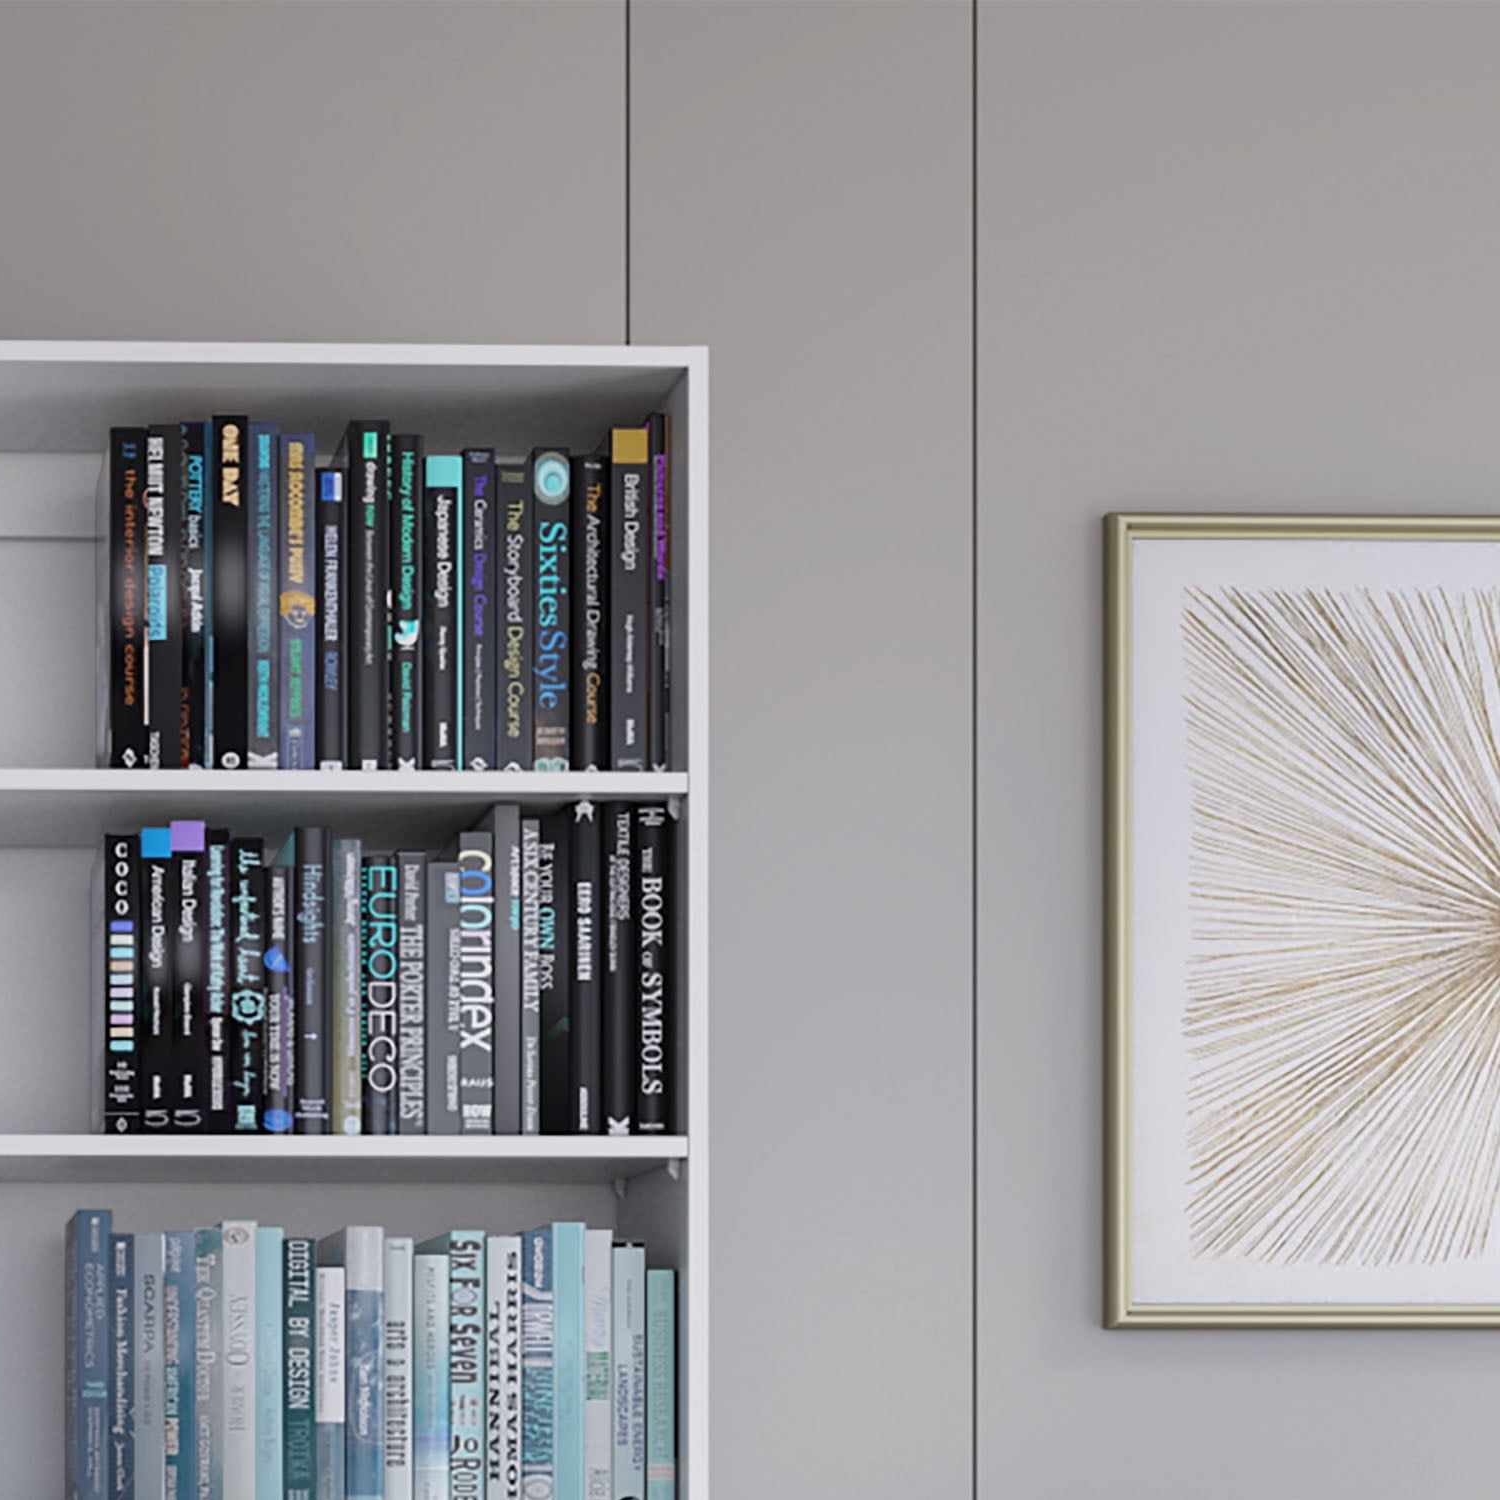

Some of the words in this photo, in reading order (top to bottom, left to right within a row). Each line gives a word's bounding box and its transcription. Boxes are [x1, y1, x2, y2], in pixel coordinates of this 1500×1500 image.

[147, 437, 164, 494] HELMUT
[221, 423, 240, 463] ONE
[122, 469, 137, 498] the
[188, 455, 203, 512] POTTERY
[221, 468, 240, 508] DAY
[396, 451, 415, 495] History
[474, 475, 487, 497] The
[586, 483, 602, 512] The
[624, 473, 640, 517] British
[147, 497, 164, 556] NEWTON
[400, 497, 415, 511] of
[434, 494, 451, 558] Japanese
[474, 499, 487, 550] Ceramics
[507, 499, 524, 532] The
[122, 504, 137, 570] interior
[400, 514, 415, 562] Modern
[586, 514, 602, 606] Architectural
[620, 520, 640, 570] Design
[396, 565, 415, 610] Design
[434, 561, 451, 608] Design
[470, 553, 487, 591] Design
[503, 534, 524, 623] Storyboard
[538, 521, 567, 628] Sixties
[118, 577, 138, 638] design
[474, 594, 487, 636] Course
[503, 626, 524, 680] Design
[581, 609, 602, 669] Drawing
[123, 645, 136, 706] course
[532, 630, 567, 709] Style
[507, 682, 524, 738] Course
[586, 672, 602, 724] Course
[523, 828, 539, 840] A
[523, 842, 539, 866] SIX
[617, 812, 630, 856] TEXTILE
[181, 860, 196, 896] Italian
[402, 864, 419, 890] David
[641, 847, 653, 873] THE
[150, 864, 165, 922] American
[297, 864, 323, 943] Hindsights
[402, 892, 419, 921] Porter
[523, 867, 539, 948] CENTURY
[577, 881, 592, 914] EERO
[617, 858, 630, 920] DESIGNERS
[640, 876, 663, 947] BOOK
[178, 898, 196, 942] Design
[399, 924, 423, 957] THE
[540, 907, 556, 950] OWN
[147, 925, 165, 969] Design
[577, 917, 592, 981] SAARINEN
[641, 951, 653, 968] OF
[368, 865, 397, 1092] EURODECO
[399, 961, 423, 1024] PORTER
[523, 951, 539, 1013] FAMILY
[640, 972, 663, 1095] SYMBOLS
[288, 1240, 309, 1307] DIGITAL
[115, 1288, 128, 1337] Fashion
[143, 1273, 155, 1353] SCARPA
[288, 1318, 309, 1338] BY
[506, 1252, 518, 1384] HARRIS
[111, 1341, 128, 1435] Merchandising
[288, 1347, 309, 1410] DESIGN
[488, 1301, 501, 1482] HANNIBAL
[617, 1364, 628, 1446] LANDSCAPES
[166, 1417, 178, 1456] POWER
[289, 1420, 309, 1480] TROIKA
[632, 1423, 643, 1472] ENERGY
